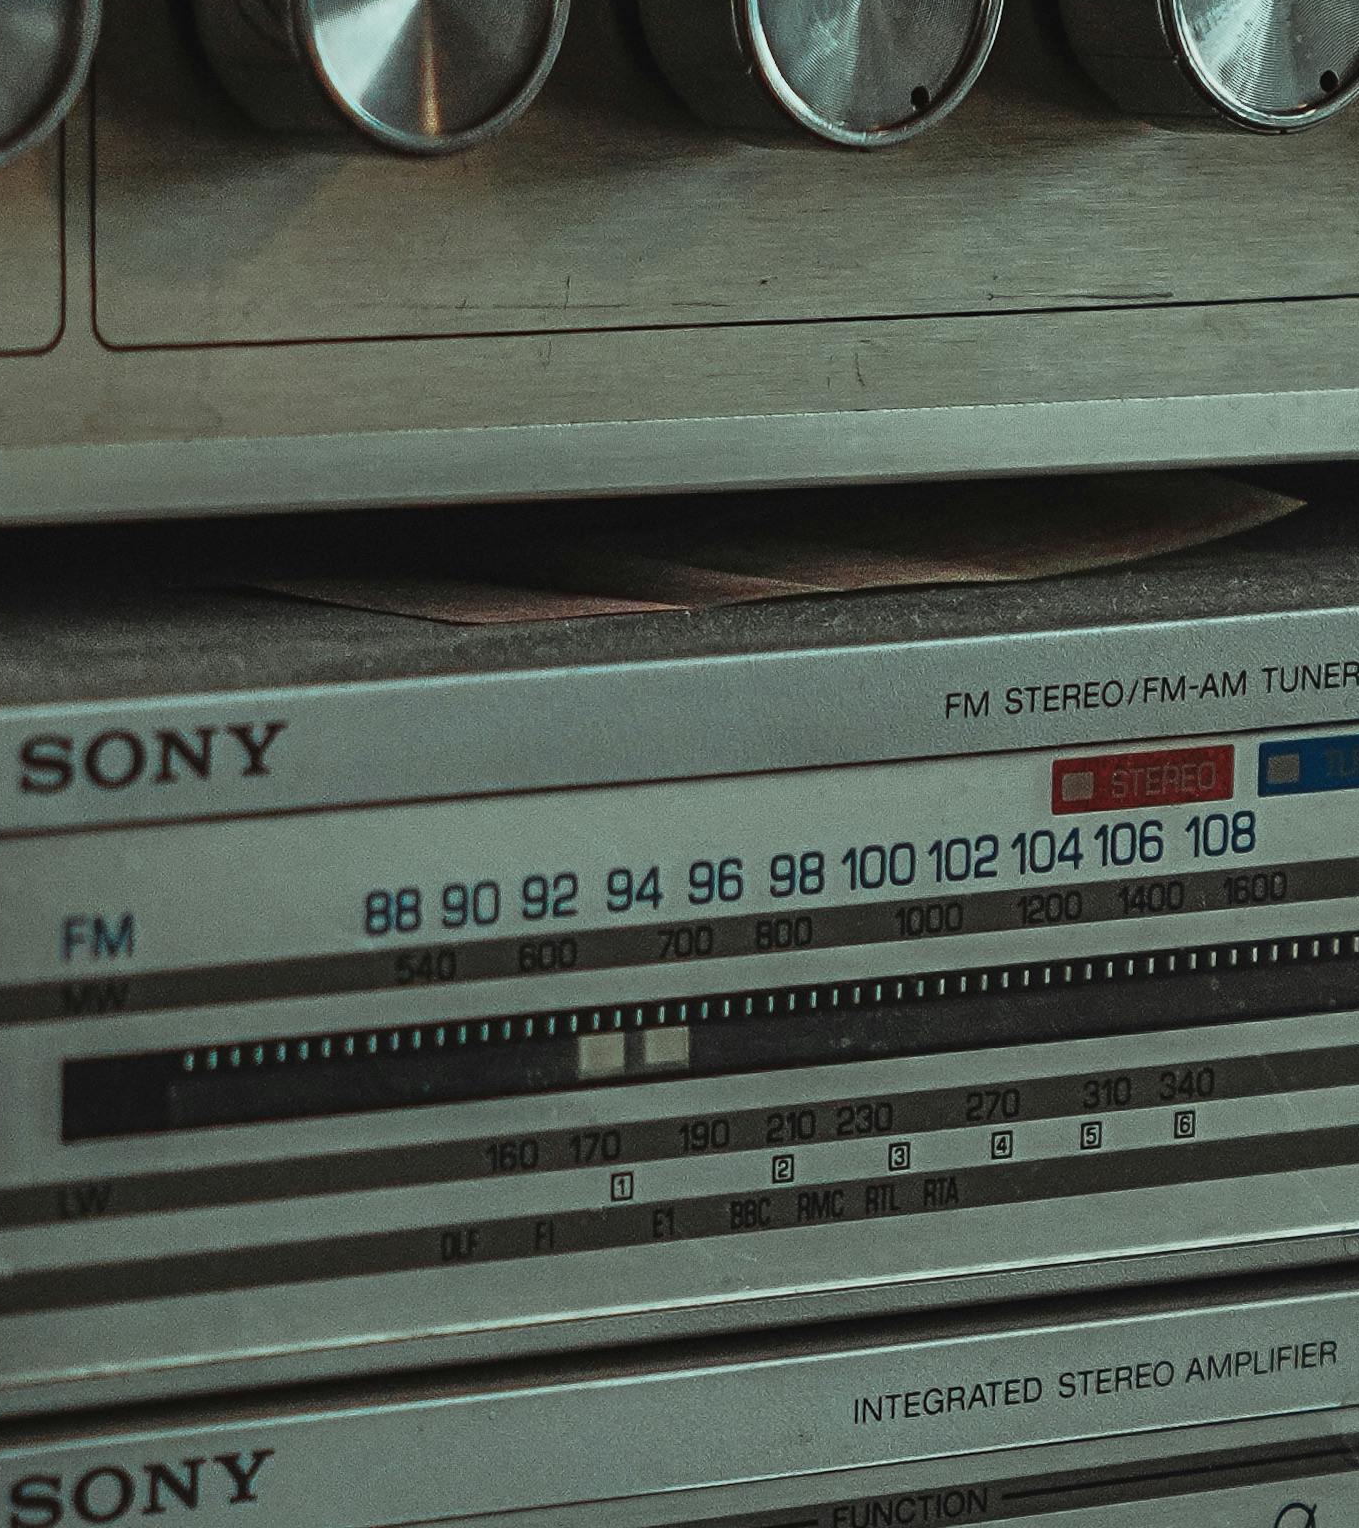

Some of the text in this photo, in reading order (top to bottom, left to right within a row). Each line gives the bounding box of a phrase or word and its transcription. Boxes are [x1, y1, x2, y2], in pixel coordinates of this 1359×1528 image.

[945, 691, 989, 720] FM
[1004, 670, 1246, 715] STEREO/FM-AM
[20, 722, 286, 793] SONY
[1111, 760, 1217, 800] STEREO
[63, 915, 135, 960] FM
[366, 889, 421, 935] 88
[442, 881, 499, 926] 90
[521, 873, 577, 919] 92
[607, 866, 662, 910] 94
[689, 858, 743, 903] 96
[769, 851, 824, 896] 98
[843, 843, 914, 889] 100
[929, 834, 999, 881] 102
[1012, 827, 1083, 873] 104
[1095, 819, 1163, 865] 106
[1186, 811, 1256, 856] 108
[64, 983, 127, 1014] MW
[396, 952, 457, 986] 540
[518, 938, 576, 972] 600
[659, 925, 712, 958] 700
[756, 915, 812, 950] 800
[896, 903, 963, 936] 1000
[1018, 891, 1082, 924] 1200
[1120, 881, 1184, 913] 1400
[1224, 871, 1287, 904] 1600
[60, 1185, 110, 1218] LW
[487, 1140, 538, 1174] 160
[570, 1130, 620, 1164] 170
[679, 1119, 729, 1153] 190
[767, 1111, 815, 1143] 210
[838, 1103, 893, 1136] 230
[966, 1090, 1020, 1123] 270
[1083, 1076, 1131, 1109] 310
[1160, 1068, 1214, 1100] 340
[731, 1198, 771, 1230] BBC
[798, 1186, 843, 1220] RMC
[865, 1180, 901, 1214] RTL
[854, 1376, 1042, 1425] INTEGRATED
[1059, 1360, 1175, 1400] STEREO
[1186, 1340, 1338, 1383] AMPLIFIER
